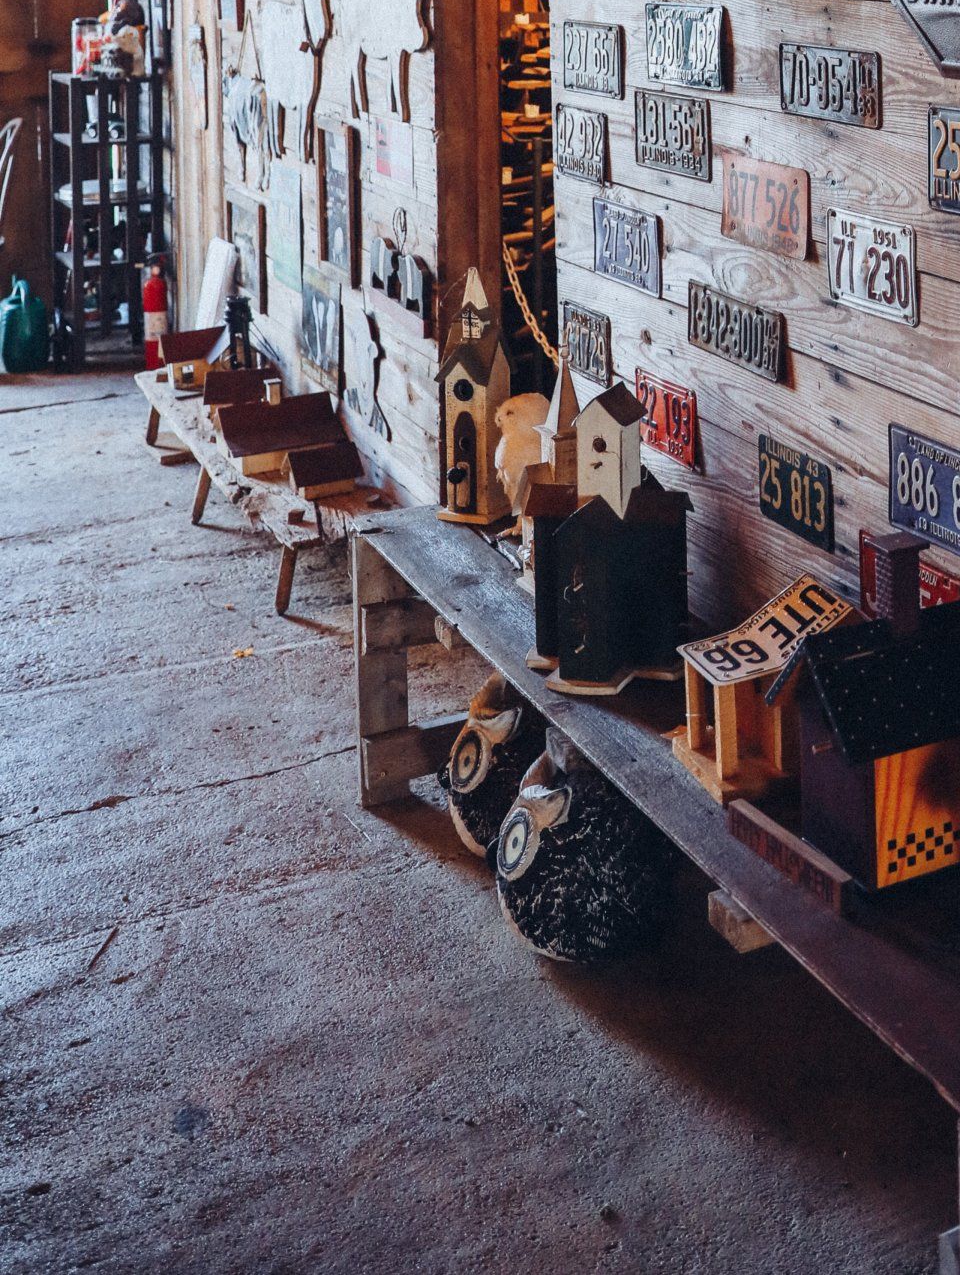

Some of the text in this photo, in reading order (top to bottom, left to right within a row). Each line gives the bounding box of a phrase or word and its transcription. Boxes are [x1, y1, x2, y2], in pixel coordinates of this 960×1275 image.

[565, 28, 618, 77] 237 667
[648, 17, 685, 70] 2580
[558, 111, 603, 163] 42 932
[729, 169, 800, 235] 877 526
[602, 217, 619, 262] 27
[623, 223, 651, 274] 540
[872, 227, 898, 249] 1951
[832, 236, 910, 310] 71 230
[662, 390, 692, 447] 193
[765, 436, 819, 478] ILLINOIS 43
[916, 440, 934, 460] LAND
[935, 451, 944, 464] OF
[760, 452, 826, 532] 25 813
[896, 451, 940, 518] 886
[918, 516, 928, 531] 19
[737, 585, 801, 636] YOUR KICKS
[702, 639, 770, 673] 66
